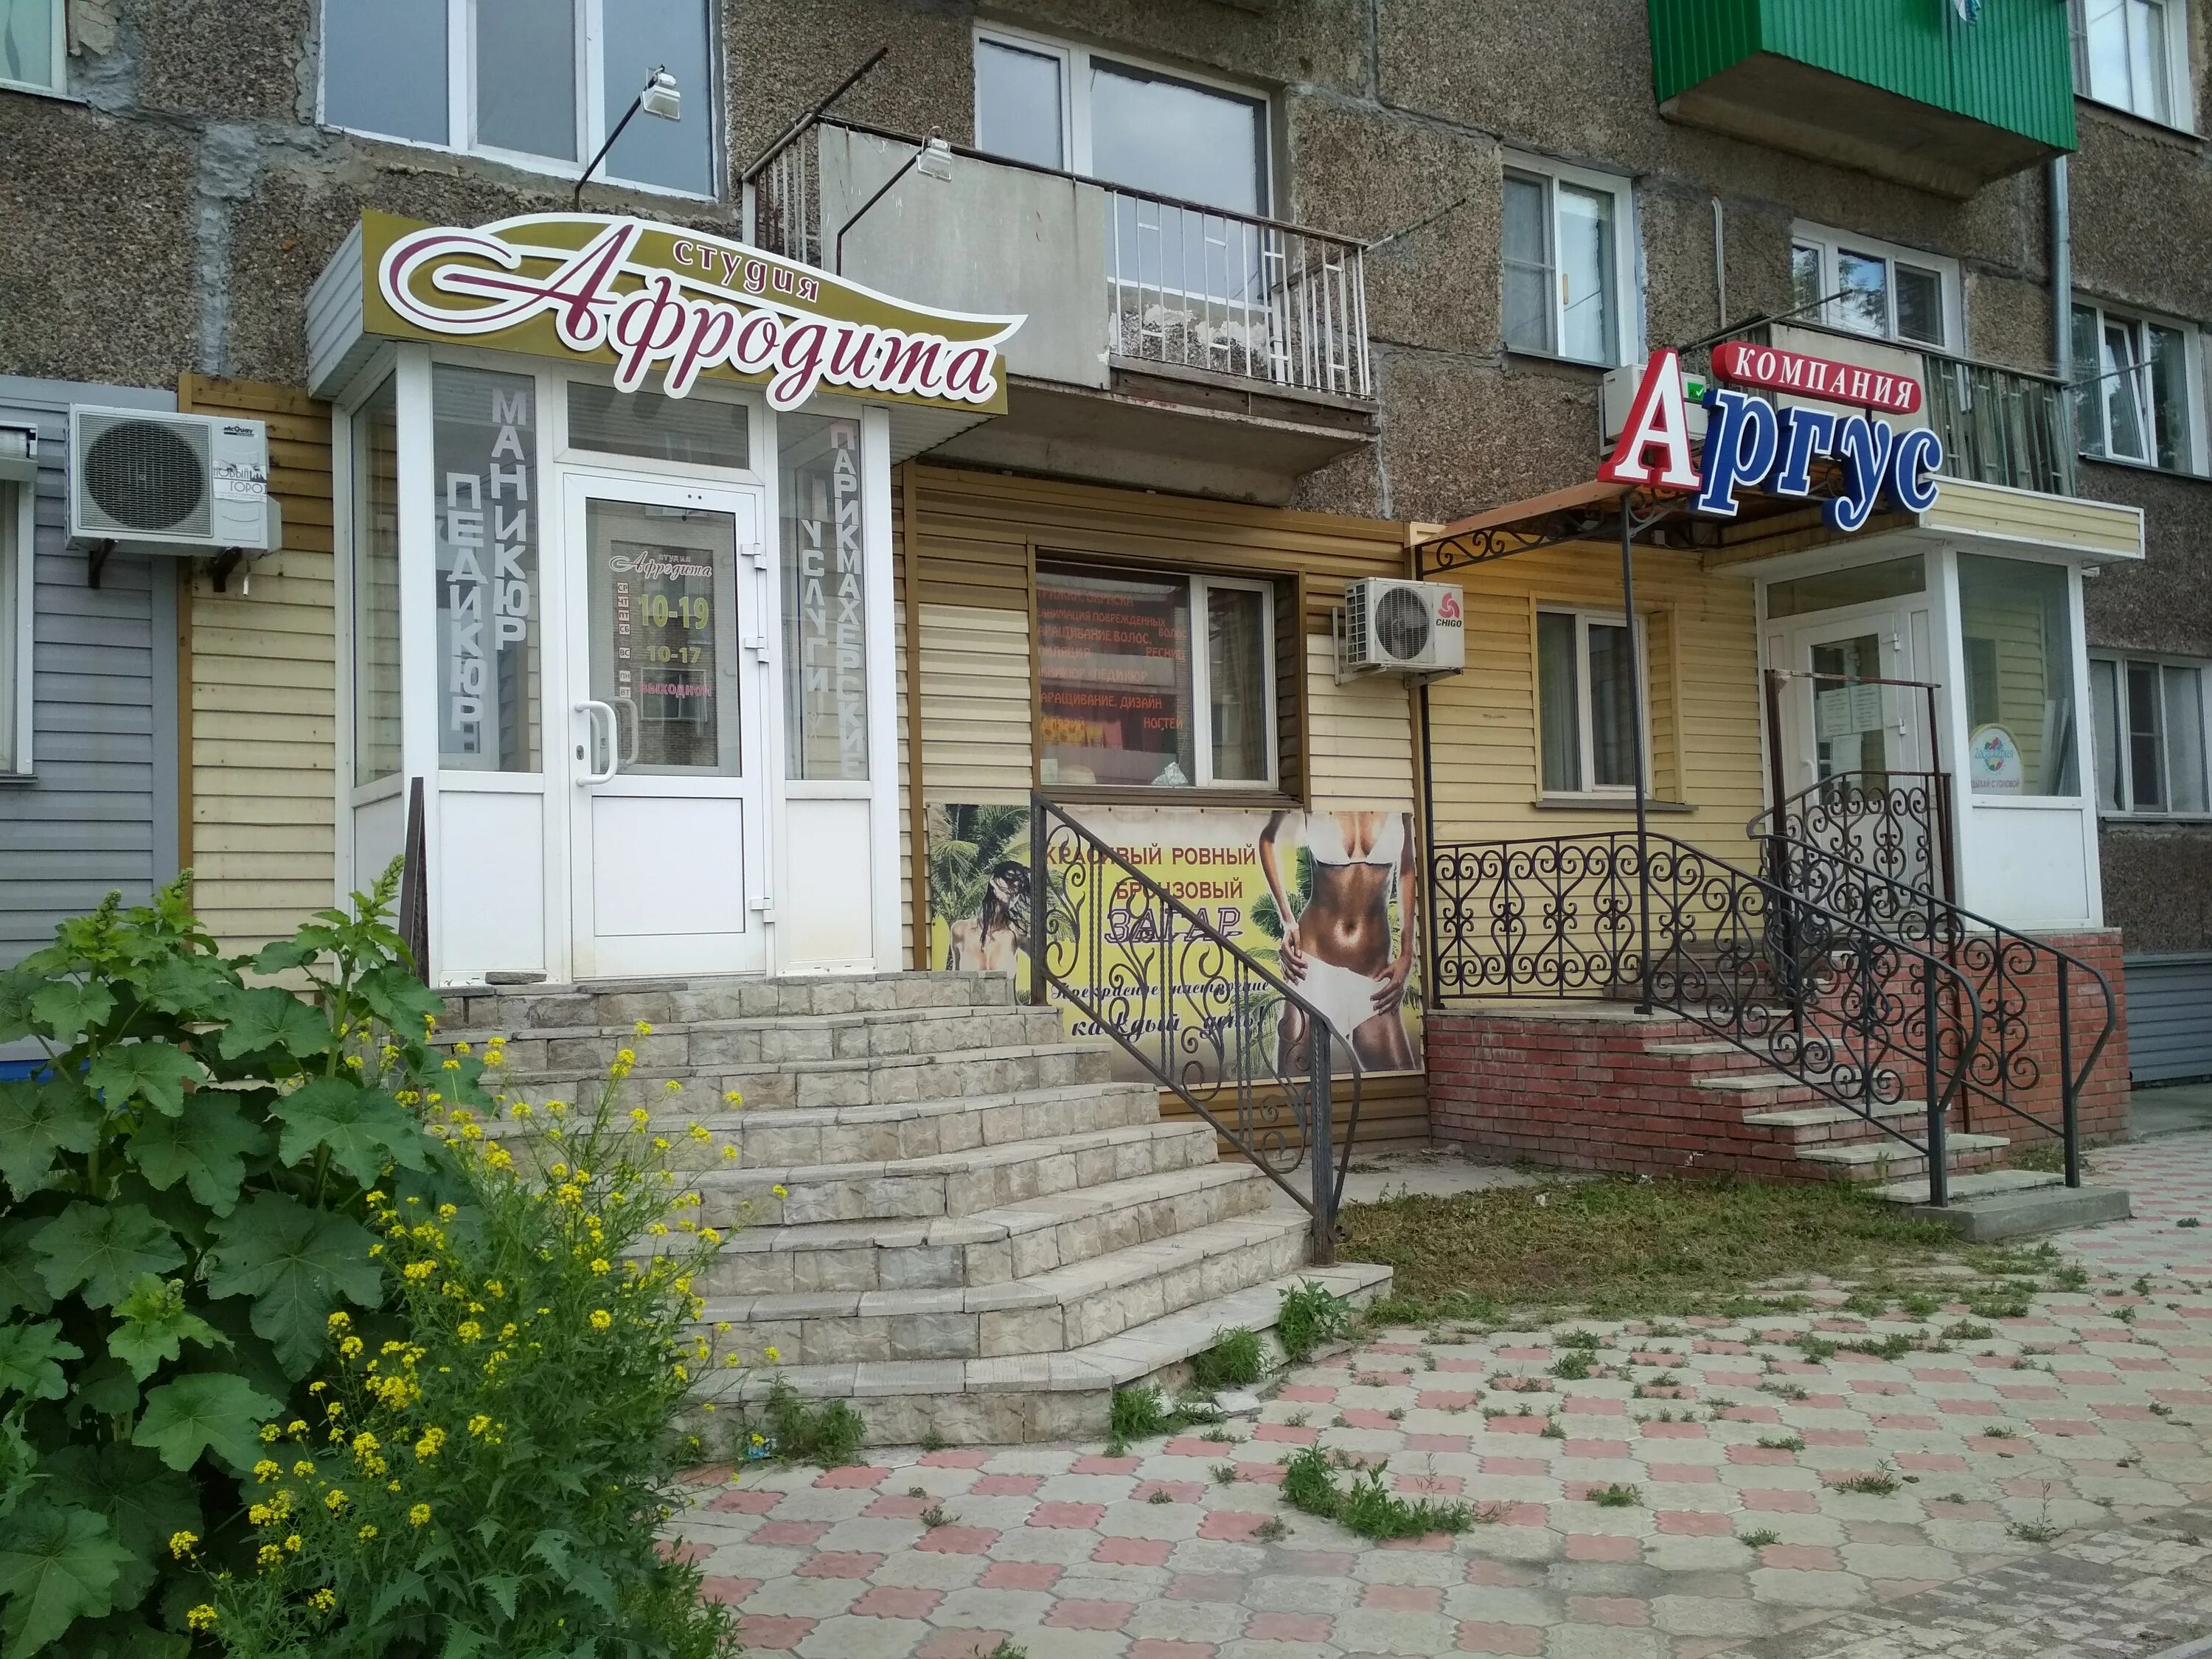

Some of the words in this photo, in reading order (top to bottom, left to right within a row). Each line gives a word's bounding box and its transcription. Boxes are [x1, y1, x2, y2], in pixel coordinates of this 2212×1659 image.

[672, 240, 820, 303] студия
[388, 223, 990, 404] Афродита
[1733, 346, 1916, 410] КОМПАНИЯ
[1598, 348, 1944, 532] Аргус
[490, 388, 530, 650] МАНИКЮР
[609, 550, 712, 581] Афродита
[446, 471, 489, 731] ПЕДИКЮР
[618, 597, 628, 605] ЧТ
[619, 611, 629, 619] ПТ
[638, 594, 709, 630] 10-19
[801, 519, 829, 693] УСЛУГИ
[830, 425, 865, 779] ПАРИКМАХЕРСКИЕ
[619, 625, 630, 633] СБ
[1093, 611, 1166, 627] ПОВРЕЖДЕННЫХ
[1436, 618, 1463, 627] CHIGO
[619, 648, 630, 657] ВС
[647, 645, 702, 664] 10-17
[640, 682, 712, 699] ВЫХОДНОЙ
[1119, 695, 1163, 709] ДИЗАЙН
[1144, 716, 1183, 730] НОГТЕЙ
[1172, 844, 1256, 865] РОВНЫЙ
[1105, 906, 1243, 944] ЗАГАР
